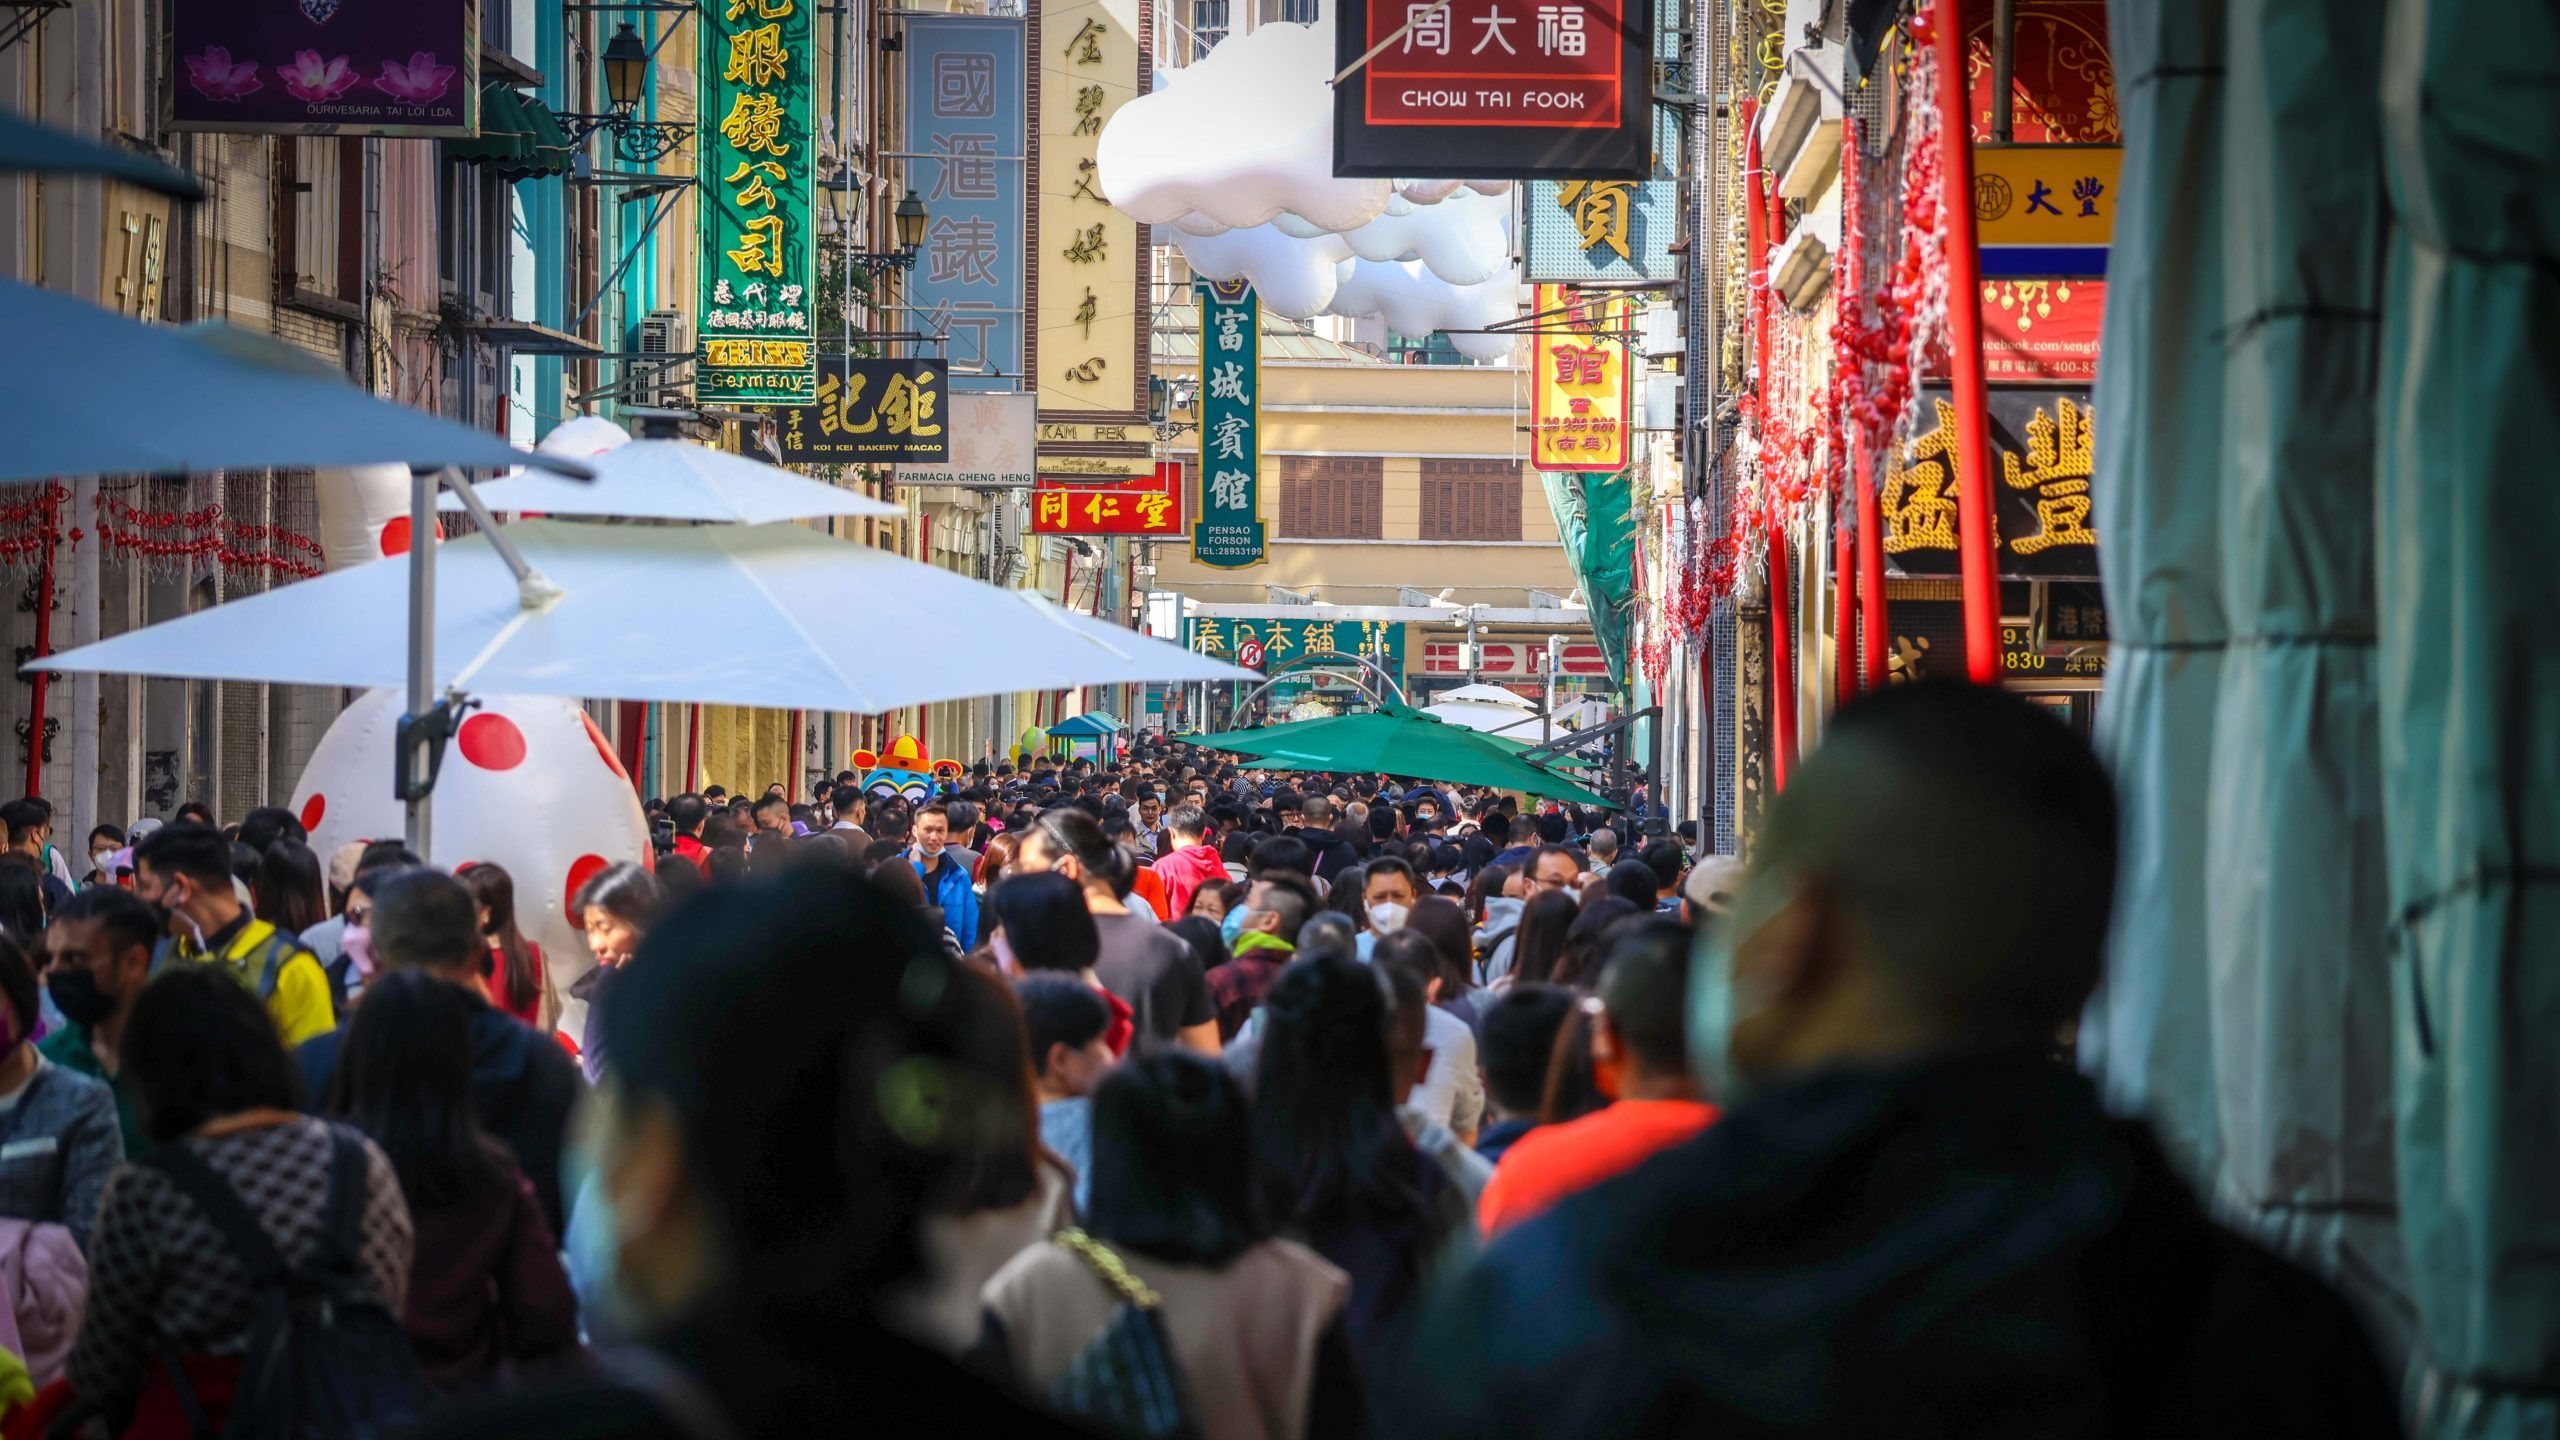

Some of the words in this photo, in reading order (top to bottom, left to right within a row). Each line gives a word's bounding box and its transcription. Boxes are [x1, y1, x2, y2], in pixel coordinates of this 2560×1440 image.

[1403, 4, 1586, 57] 周大福
[1402, 90, 1467, 108] CHOW
[1476, 91, 1511, 108] TAI
[1523, 92, 1585, 109] FOOK
[307, 104, 381, 116] OURIVESARIA
[386, 106, 402, 116] TAI
[408, 107, 425, 117] LOI
[431, 108, 455, 118] LDA.
[1983, 111, 2026, 124] PE
[2025, 178, 2105, 218] 大豐
[706, 340, 807, 367] ZEISS
[1983, 337, 2101, 355] cebook.com/sengf
[710, 373, 803, 392] Germany
[1208, 308, 1251, 511] 富城賓館
[784, 409, 804, 451] 手信
[1042, 424, 1078, 440] KAM
[1094, 426, 1127, 440] PEK
[958, 473, 996, 482] CHENG
[1001, 473, 1031, 482] HENG
[1040, 486, 1173, 529] 同仁堂
[1208, 526, 1251, 535] PENSAO
[1208, 536, 1251, 545] FORSON
[1196, 547, 1263, 556] TEL:28933199
[2000, 652, 2045, 670] 830
